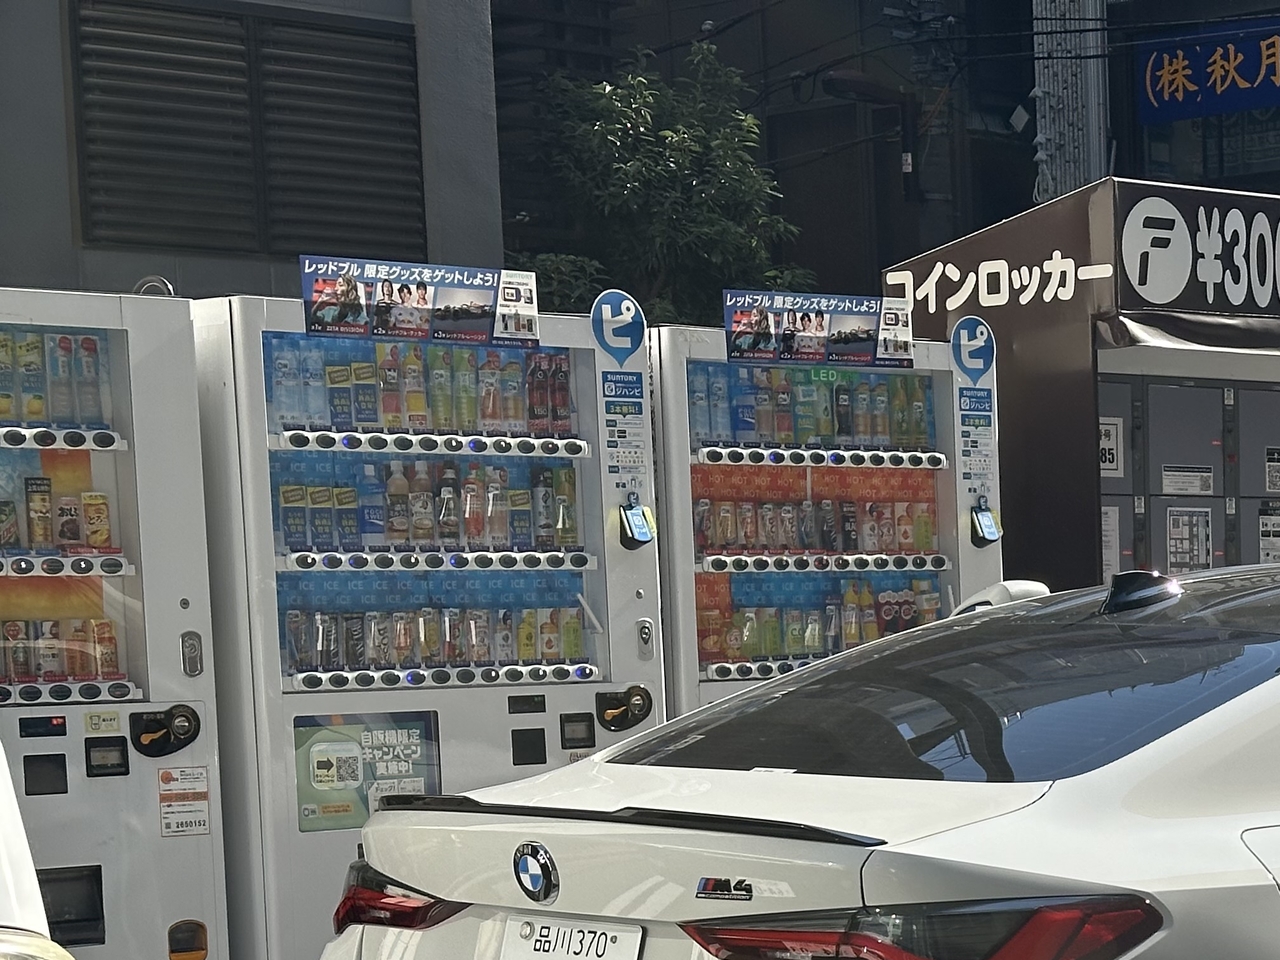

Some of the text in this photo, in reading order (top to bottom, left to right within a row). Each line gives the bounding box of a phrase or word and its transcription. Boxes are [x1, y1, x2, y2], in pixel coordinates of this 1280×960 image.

[304, 259, 361, 278] レッドブル
[886, 249, 1114, 314] コインロッカー
[811, 369, 837, 381] LED
[361, 745, 421, 762] キャンペーン
